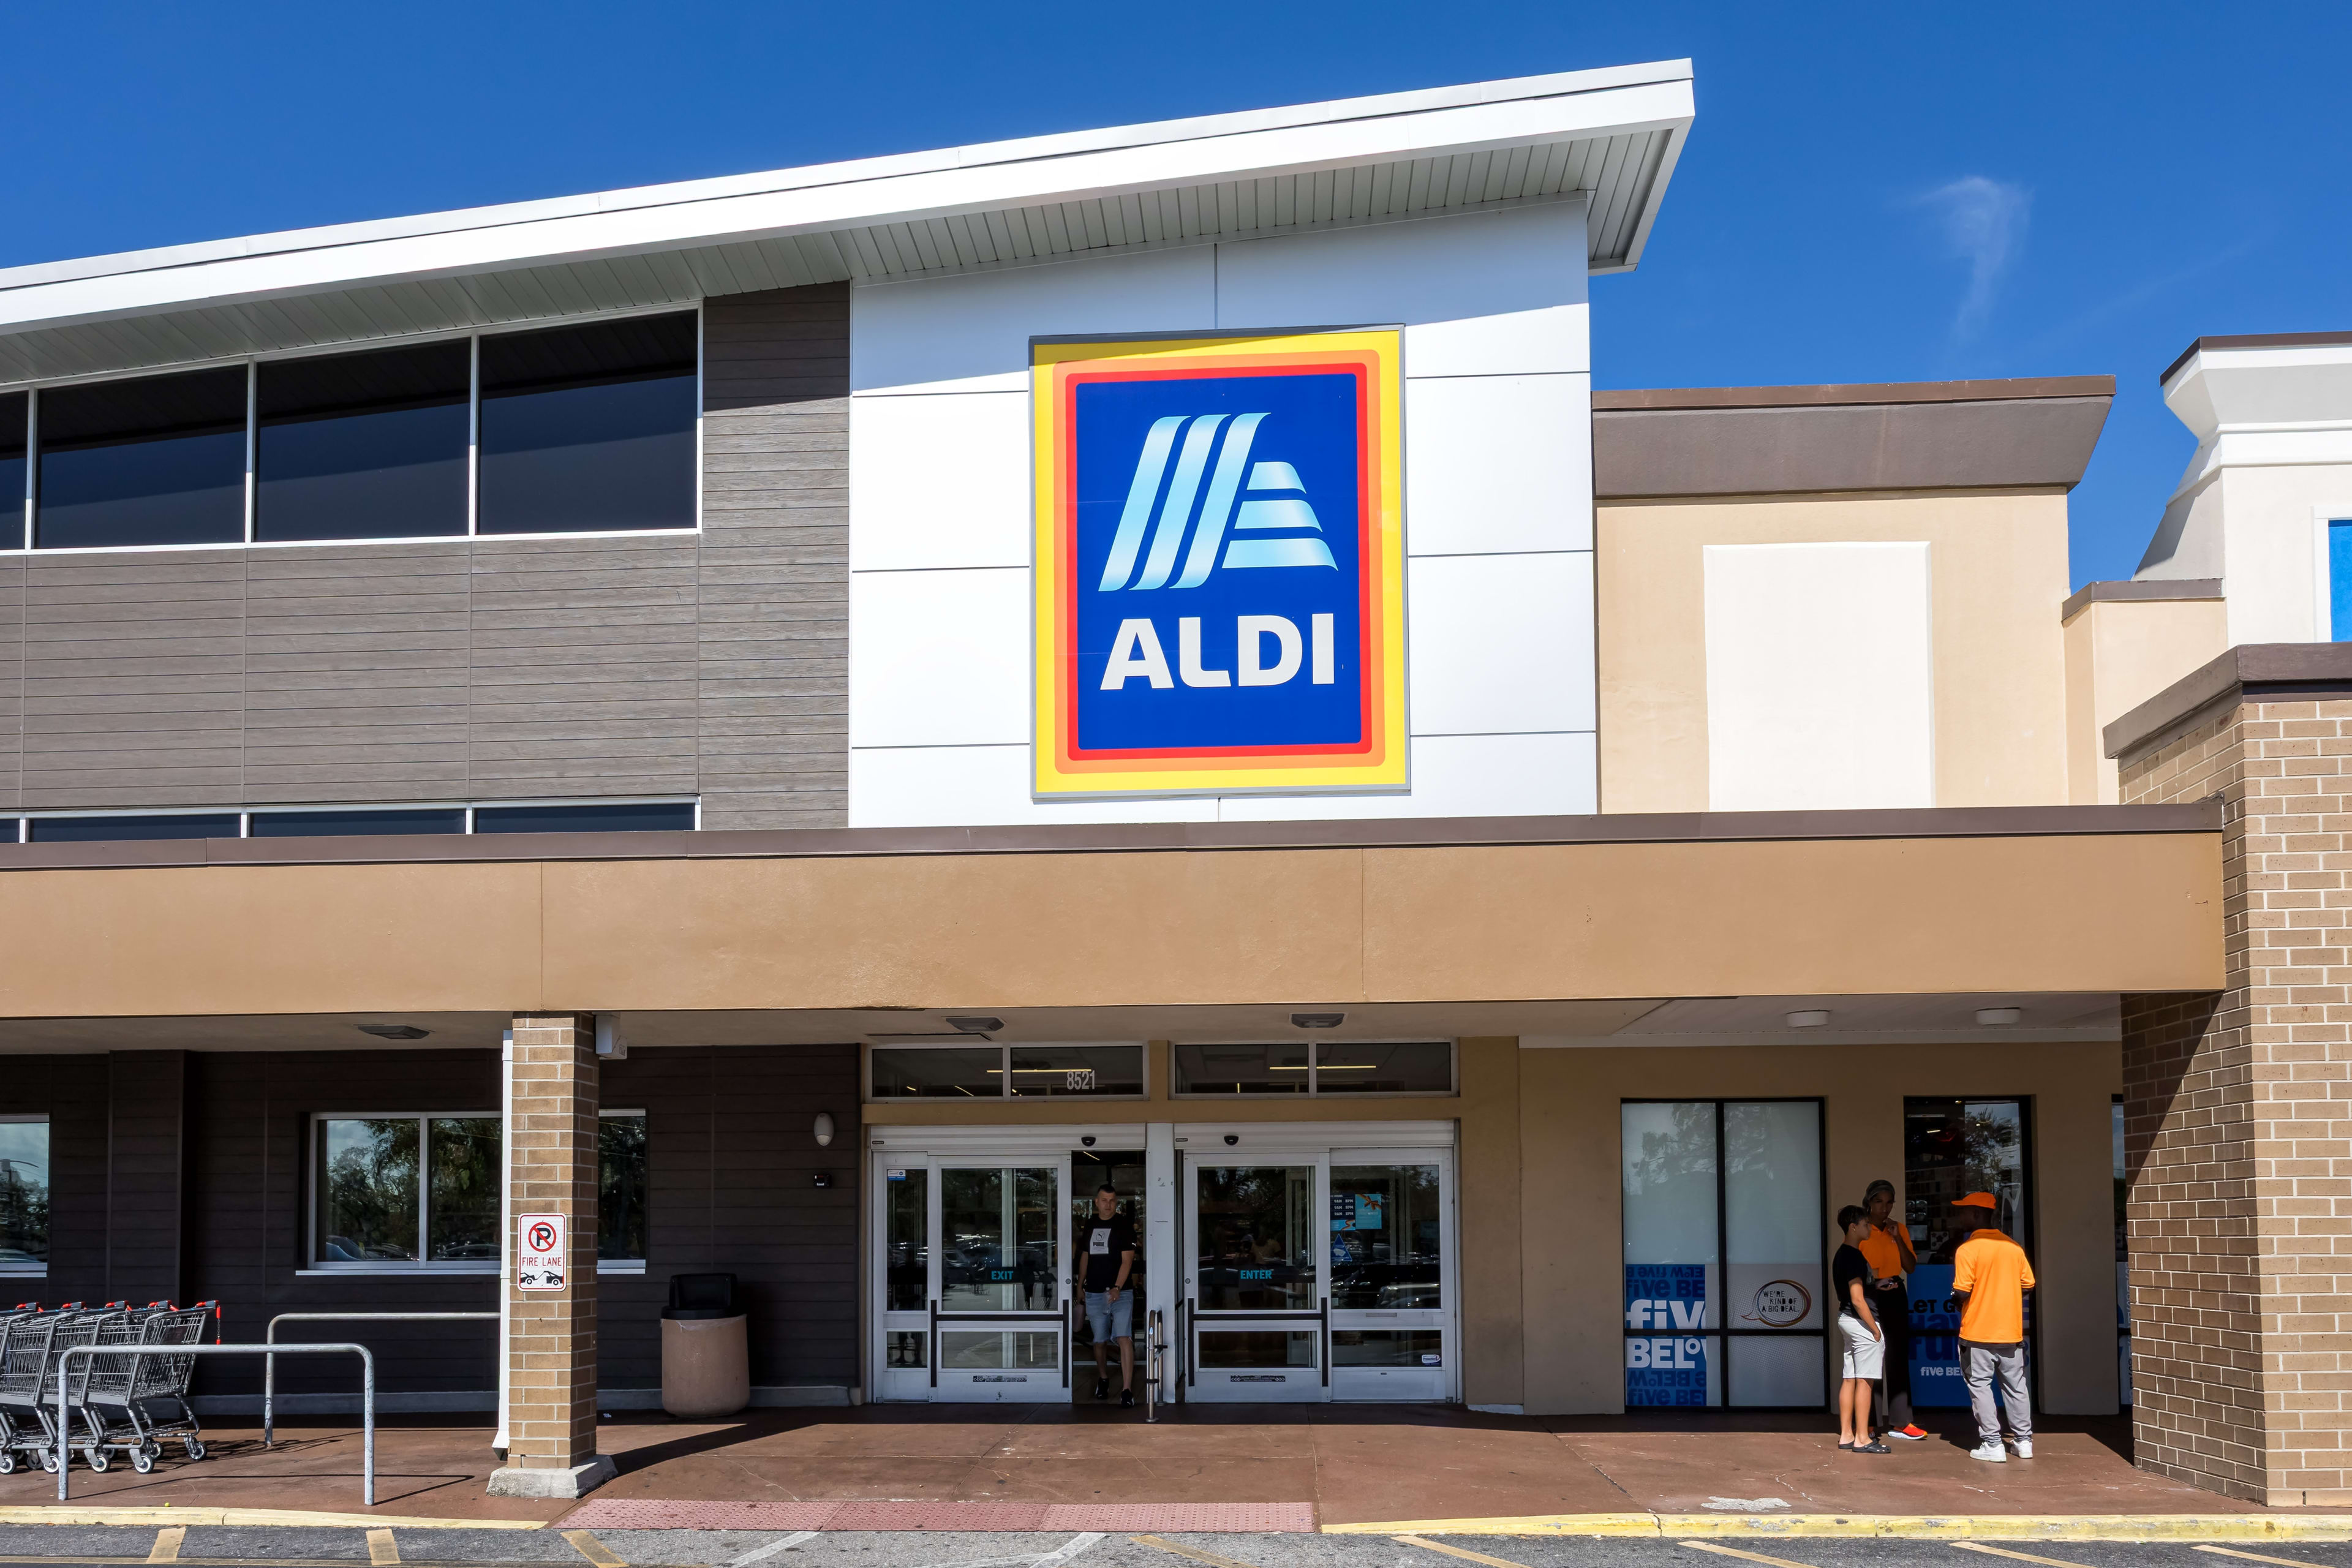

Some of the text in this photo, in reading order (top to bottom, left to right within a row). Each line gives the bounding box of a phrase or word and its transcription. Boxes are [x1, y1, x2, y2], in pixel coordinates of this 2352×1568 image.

[1099, 612, 1335, 690] ALDI
[1066, 1070, 1095, 1090] 8521
[522, 1257, 562, 1267] FIRE LANE
[991, 1270, 1014, 1280] EXIT
[1240, 1270, 1273, 1280] ENTER
[1626, 1299, 1706, 1336] fiv
[1920, 1366, 1944, 1376] five
